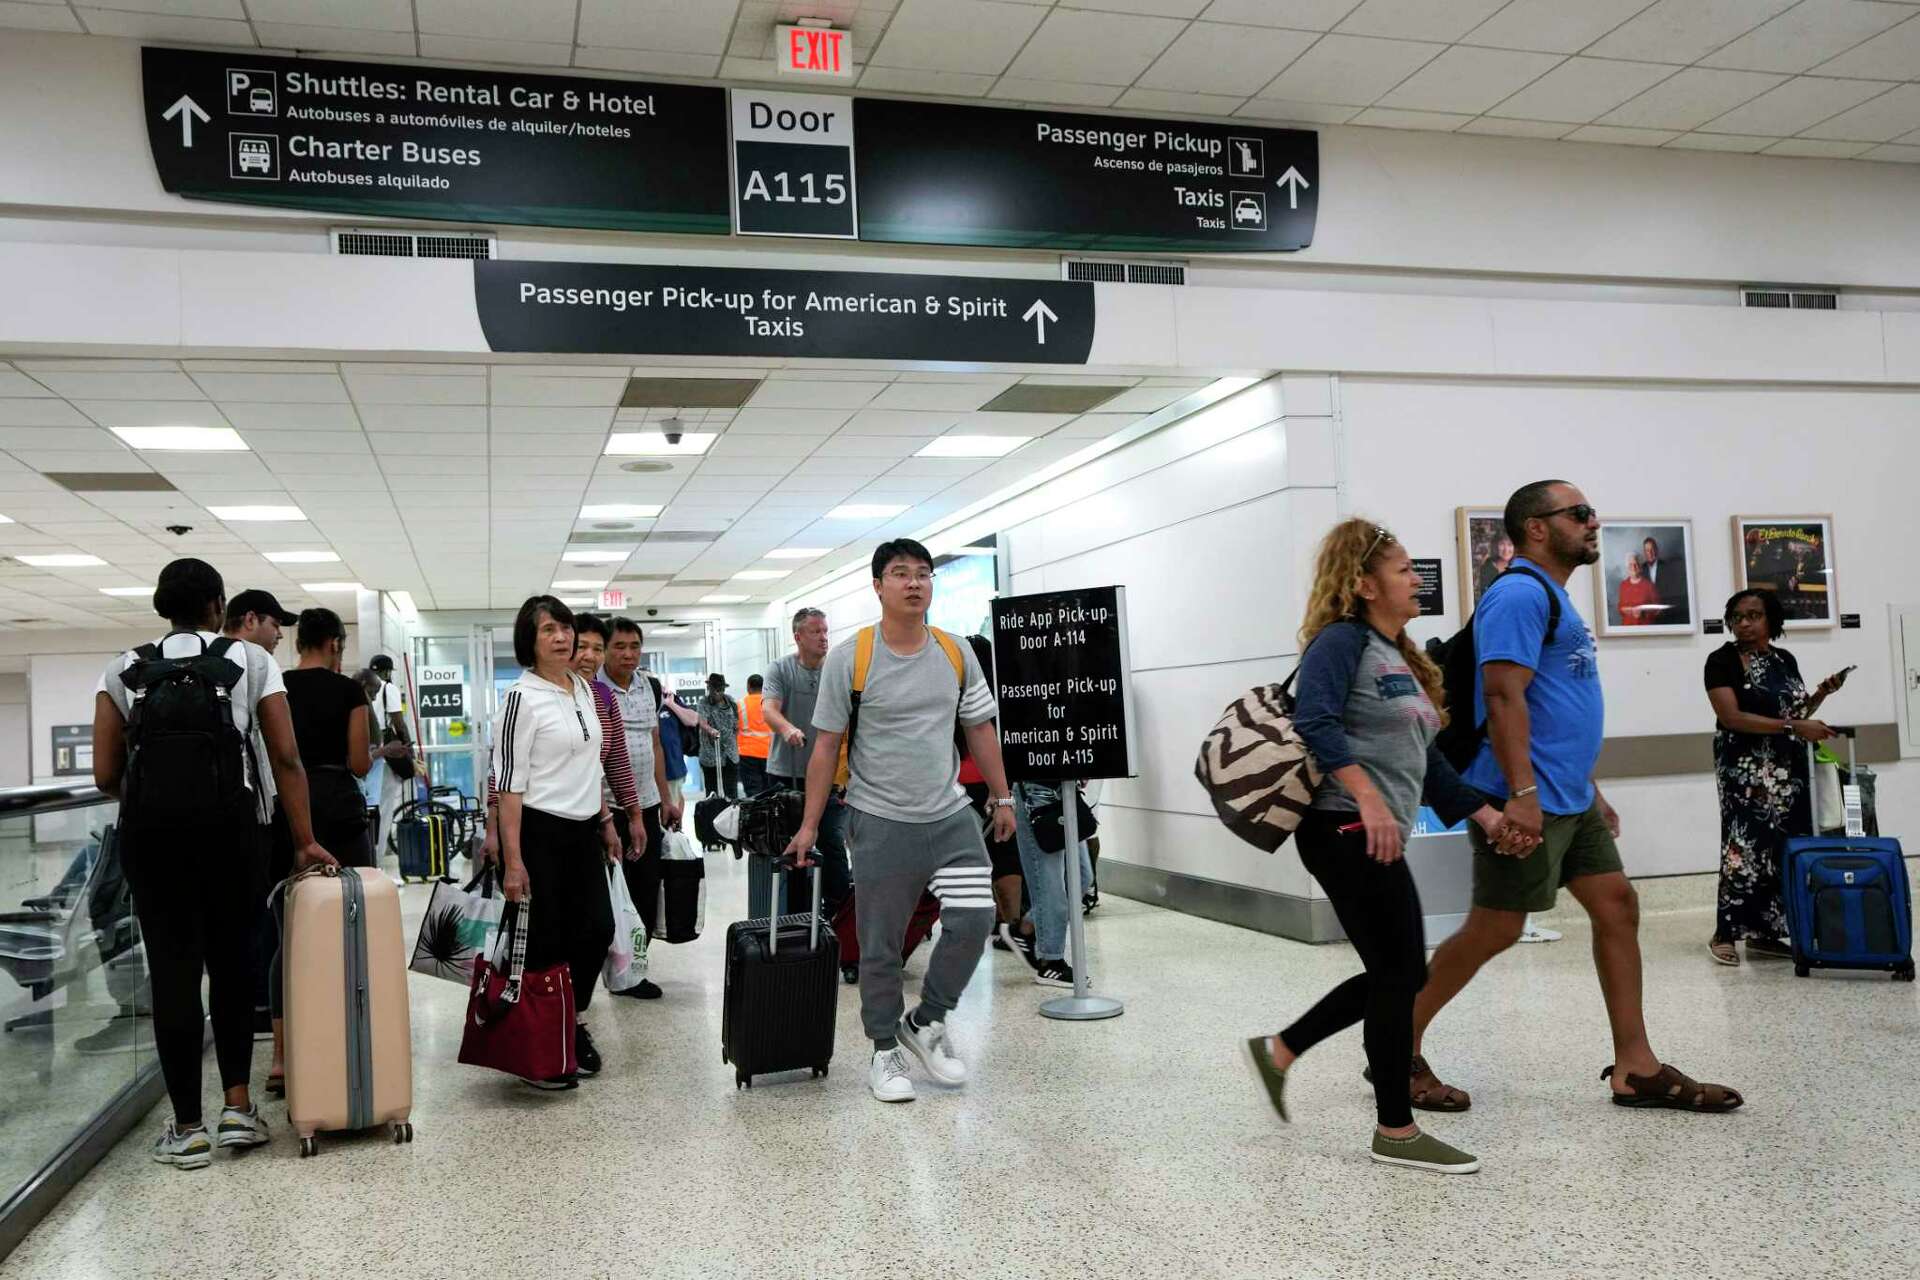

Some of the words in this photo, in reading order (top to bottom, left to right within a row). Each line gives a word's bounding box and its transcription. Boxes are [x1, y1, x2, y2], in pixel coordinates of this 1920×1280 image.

[790, 29, 842, 72] EXIT
[287, 72, 405, 99] Shuttles:
[416, 81, 500, 105] Rental
[510, 88, 553, 108] Car
[563, 91, 580, 110] &
[589, 92, 656, 115] Hotel
[287, 106, 370, 122] Autobuses
[376, 114, 384, 123] a
[391, 114, 483, 129] automóviles
[488, 118, 506, 130] de
[512, 120, 630, 137] alquiler/hoteles
[750, 102, 834, 132] Door
[289, 136, 392, 160] Charter
[403, 142, 480, 165] Buses
[1038, 124, 1146, 151] Passenger
[1155, 132, 1221, 158] Pickup
[1094, 157, 1144, 170] Ascenso
[1148, 160, 1163, 171] de
[1167, 163, 1223, 176] pasajeros
[289, 169, 373, 185] Autobuses
[378, 174, 449, 190] alquilado
[743, 170, 847, 205] A115
[1174, 187, 1224, 207] Taxis
[1197, 217, 1225, 229] Taxis
[520, 283, 653, 311] Passenger
[663, 288, 753, 314] Pick-up
[762, 290, 796, 310] for
[805, 291, 916, 315] American
[926, 300, 941, 315] &
[948, 297, 1007, 320] Spirit
[744, 315, 804, 336] Taxis
[1000, 614, 1024, 629] Ride
[1030, 612, 1052, 629] App
[1058, 606, 1108, 623] Pick-up
[1020, 635, 1047, 650] Door
[1054, 630, 1086, 647] A-114
[424, 670, 456, 680] Door
[679, 679, 702, 687] Door
[1001, 681, 1061, 700] Passenger
[1067, 676, 1117, 695] Pick-up
[421, 694, 461, 707] A115
[1047, 703, 1066, 719] for
[1003, 727, 1059, 744] American
[1066, 727, 1074, 741] &
[1080, 724, 1118, 744] Spirit
[1028, 751, 1056, 766] Door
[1062, 749, 1094, 765] A-115
